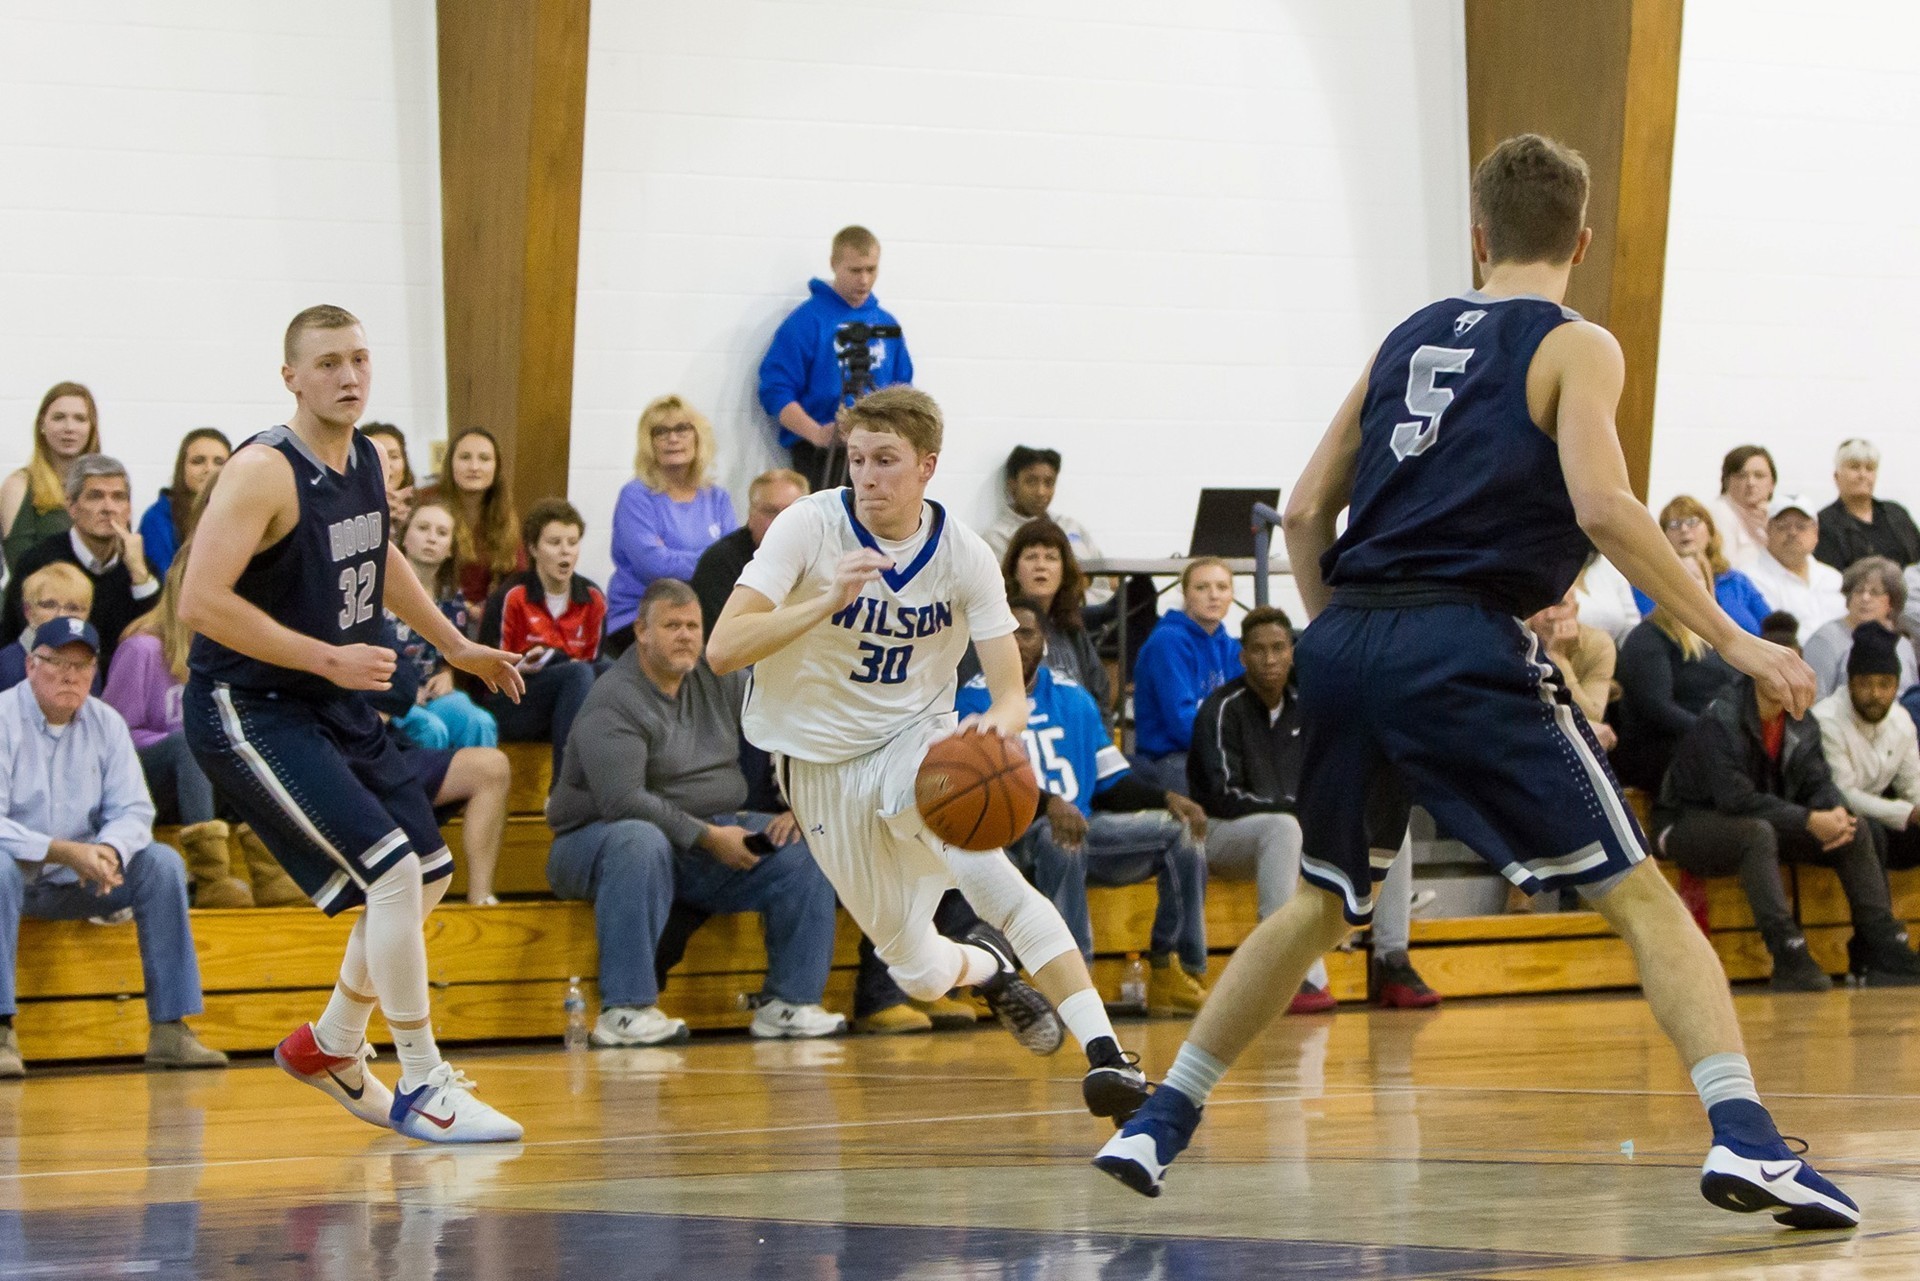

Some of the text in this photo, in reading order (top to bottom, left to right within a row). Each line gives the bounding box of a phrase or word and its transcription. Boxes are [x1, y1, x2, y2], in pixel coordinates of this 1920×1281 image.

[1389, 344, 1476, 462] 5
[328, 511, 382, 562] HOOD
[338, 560, 376, 630] 32
[830, 596, 953, 639] WILSON
[849, 640, 914, 684] 30
[1020, 726, 1079, 803] 15
